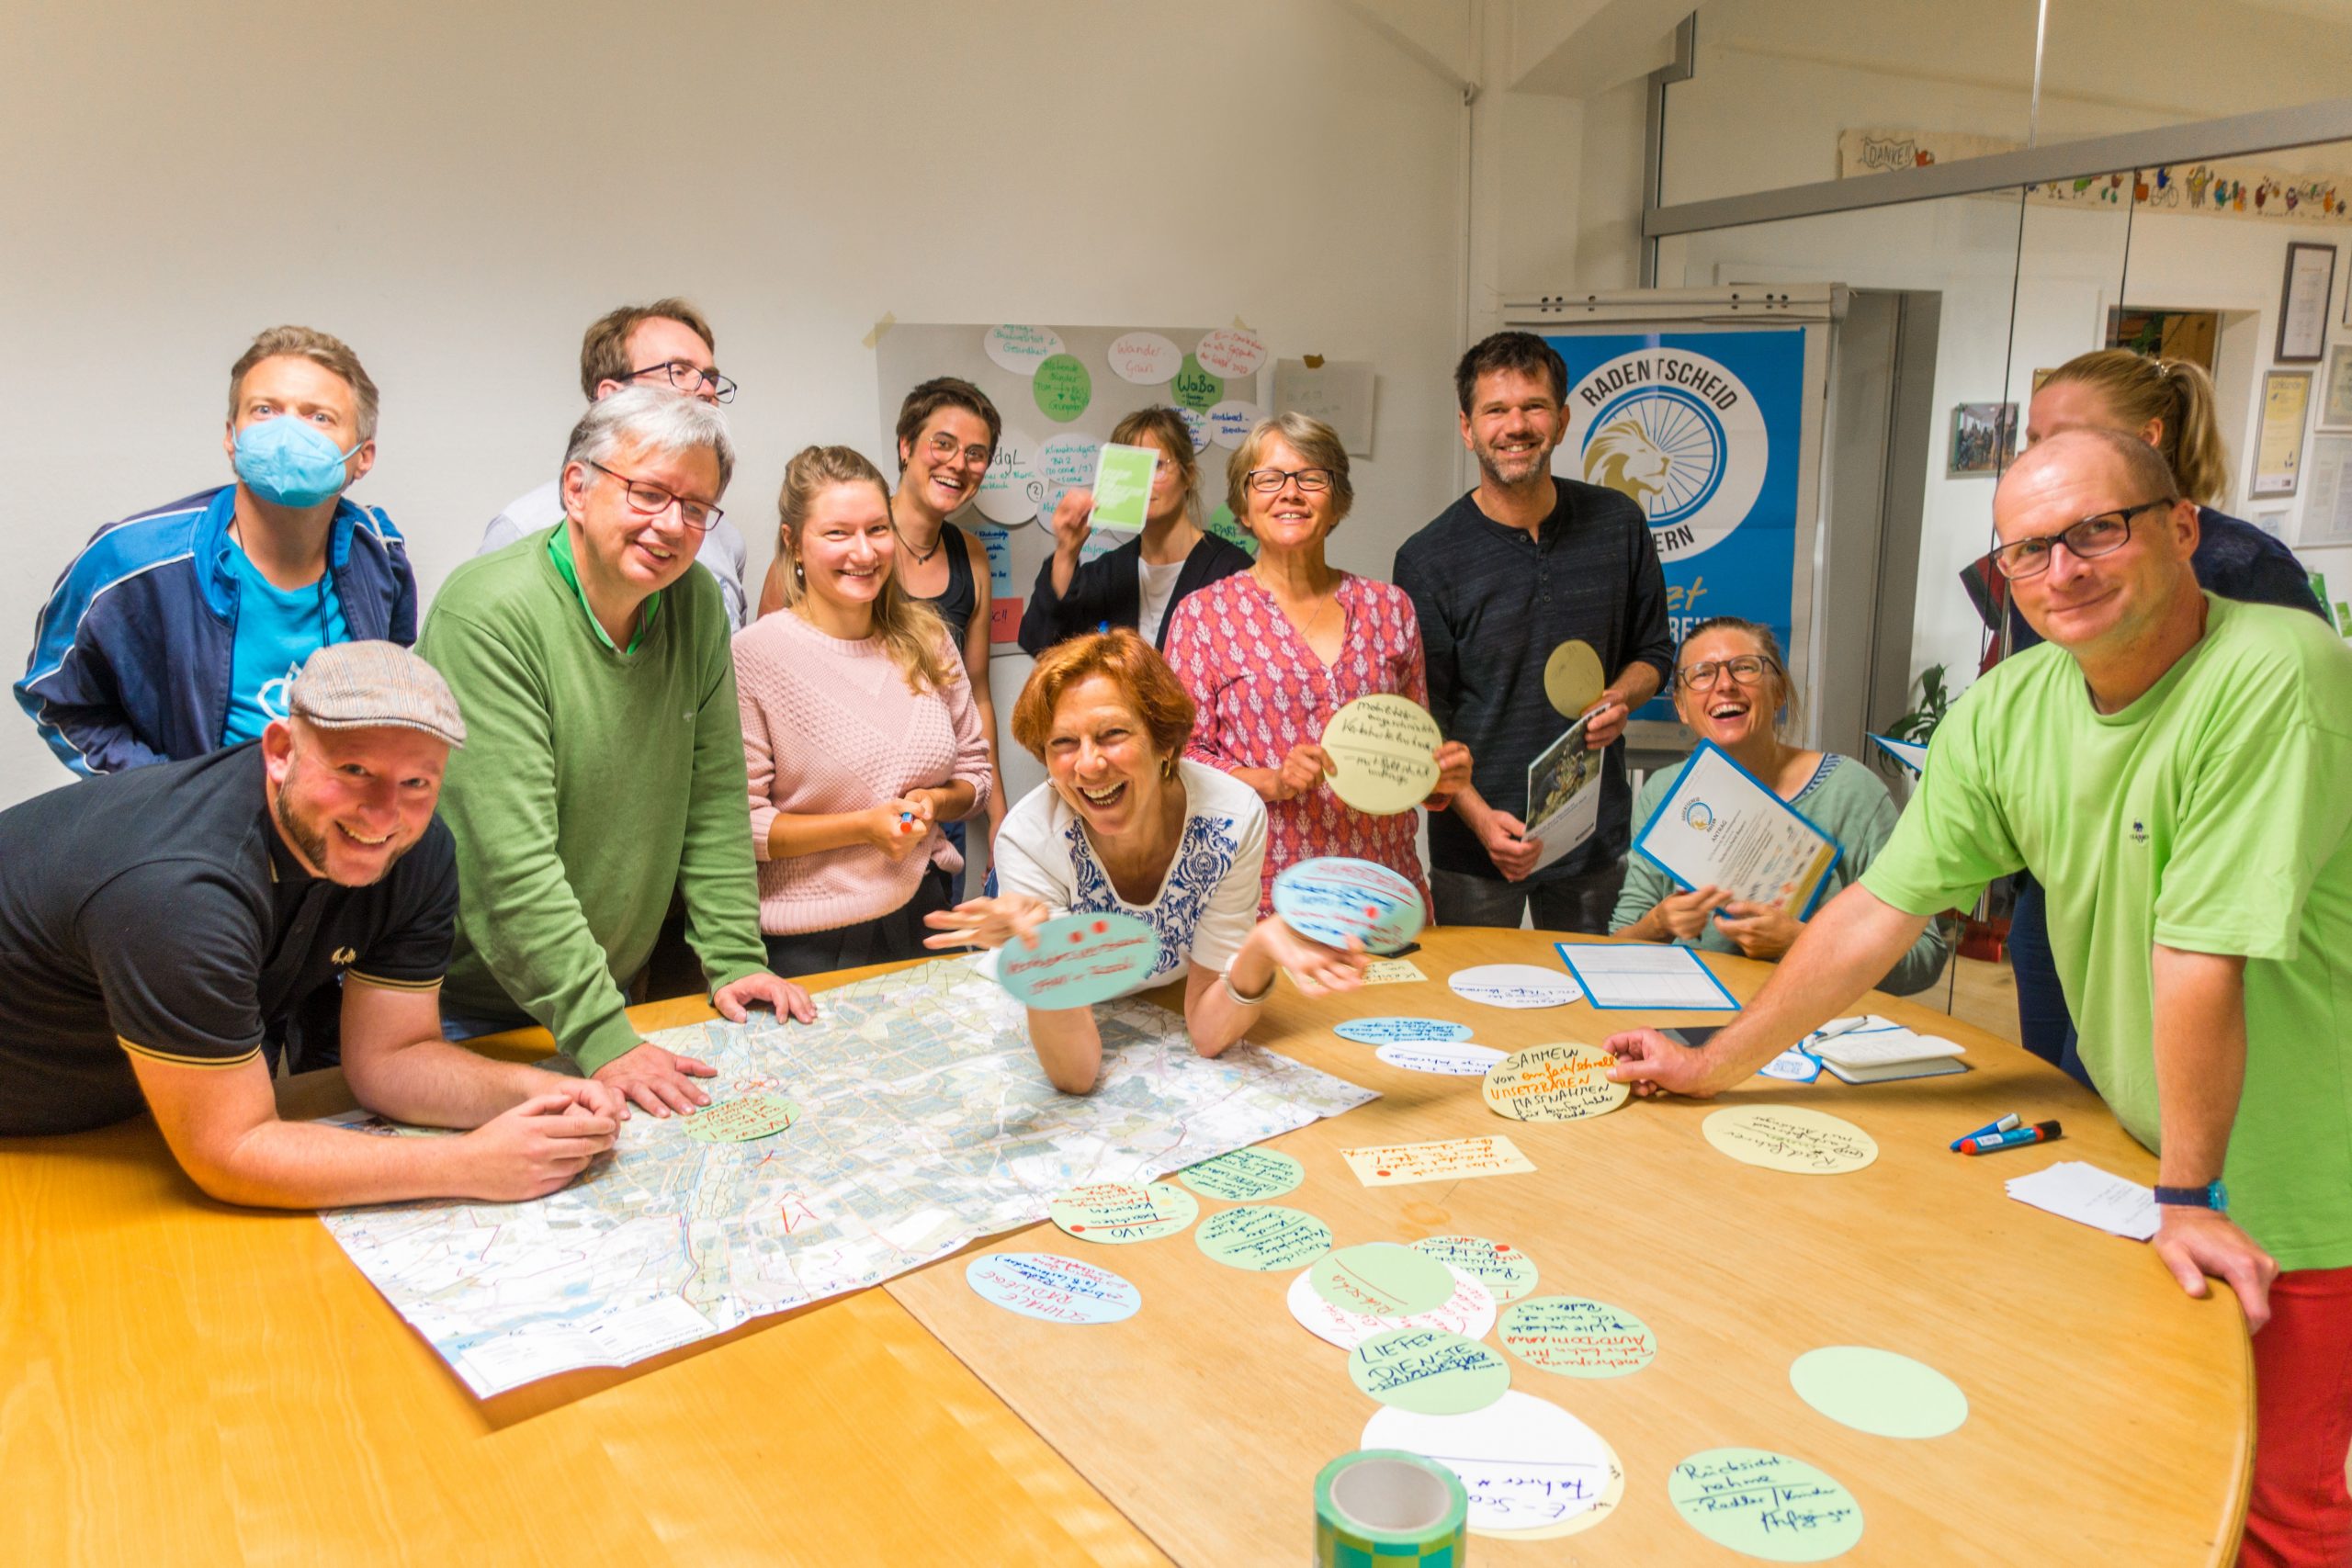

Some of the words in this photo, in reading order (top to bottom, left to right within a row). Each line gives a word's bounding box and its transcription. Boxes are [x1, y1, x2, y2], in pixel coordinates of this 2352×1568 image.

[1177, 374, 1216, 394] WaBa
[1579, 357, 1738, 413] RADENTSCHEID
[1653, 525, 1695, 553] ERN
[1711, 820, 1728, 842] ANTRAG
[1506, 1047, 1579, 1071] SAMMELN
[1493, 1075, 1516, 1085] von
[975, 1271, 1074, 1306] RADWEGE
[998, 1293, 1092, 1323] SCHMALE
[1367, 1342, 1473, 1381] DIENSTE
